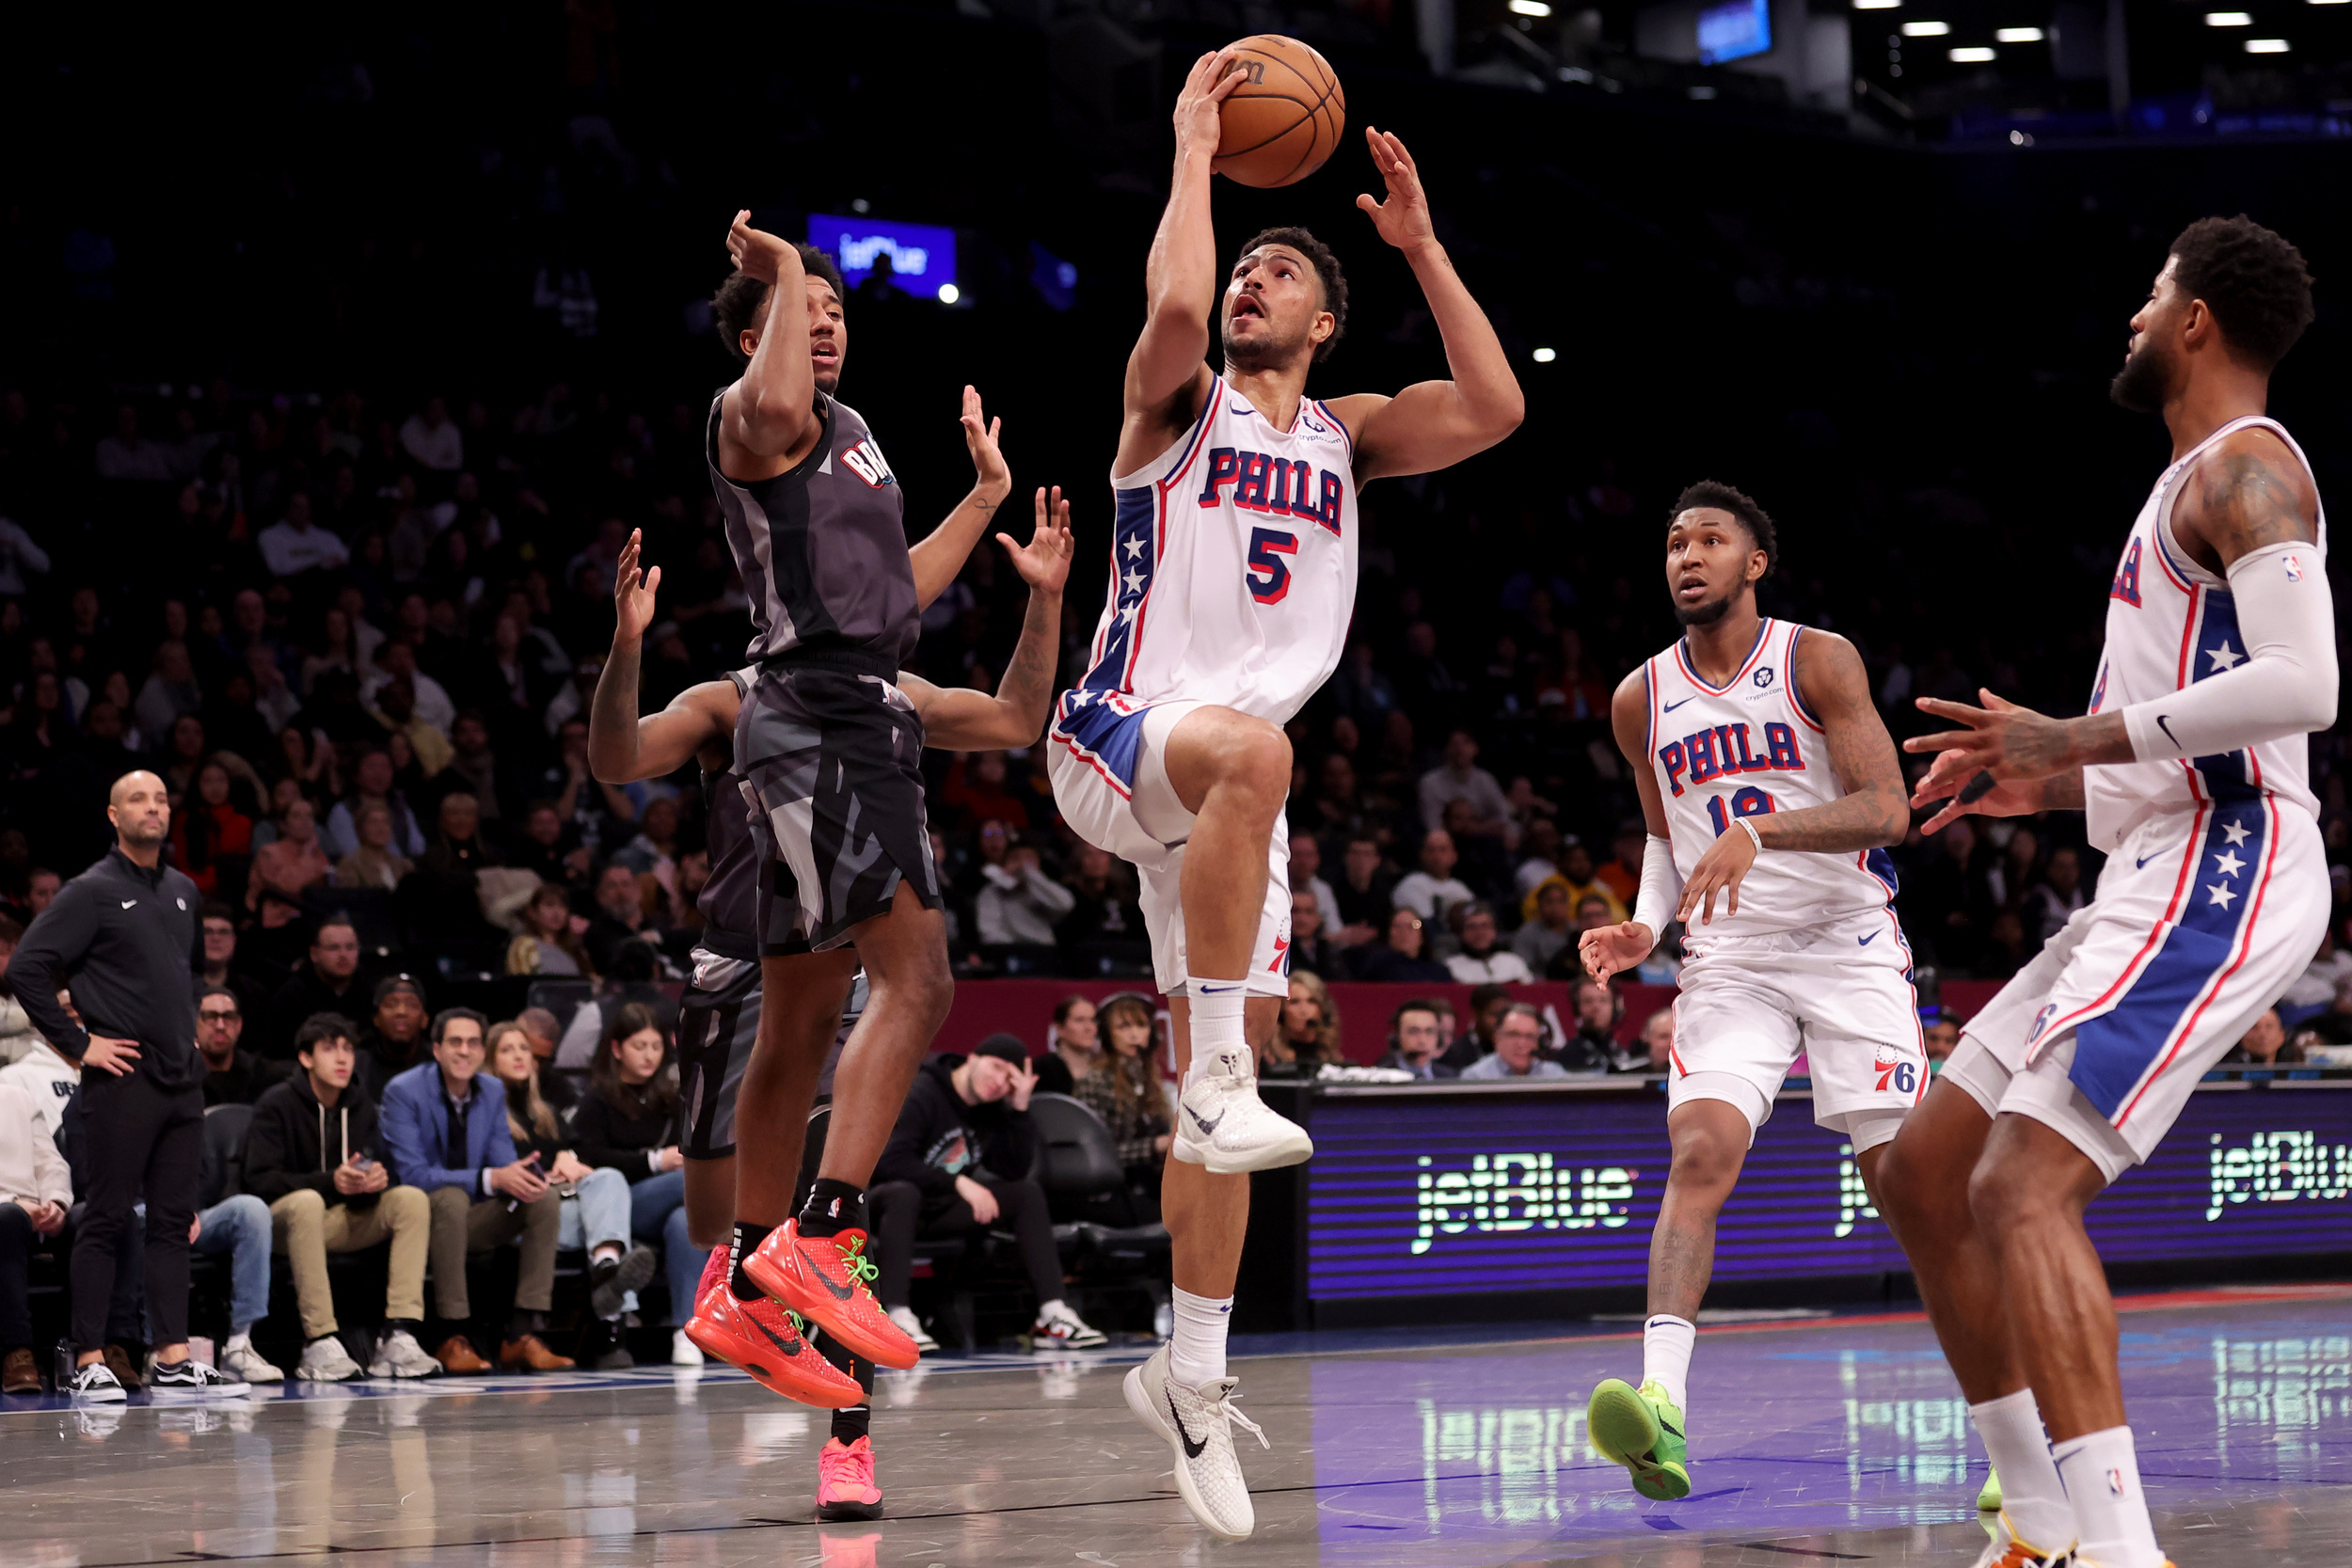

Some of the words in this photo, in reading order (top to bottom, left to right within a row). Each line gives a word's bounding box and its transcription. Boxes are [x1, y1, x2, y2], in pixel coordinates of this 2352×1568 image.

[1199, 447, 1343, 538] PHILA
[1246, 526, 1299, 606] 5
[1745, 687, 1786, 702] crypto.com
[1659, 721, 1806, 799] PHILA
[1874, 1058, 1915, 1093] 76
[1410, 1152, 1635, 1255] jetBlue
[2205, 1130, 2352, 1222] jetBlu
